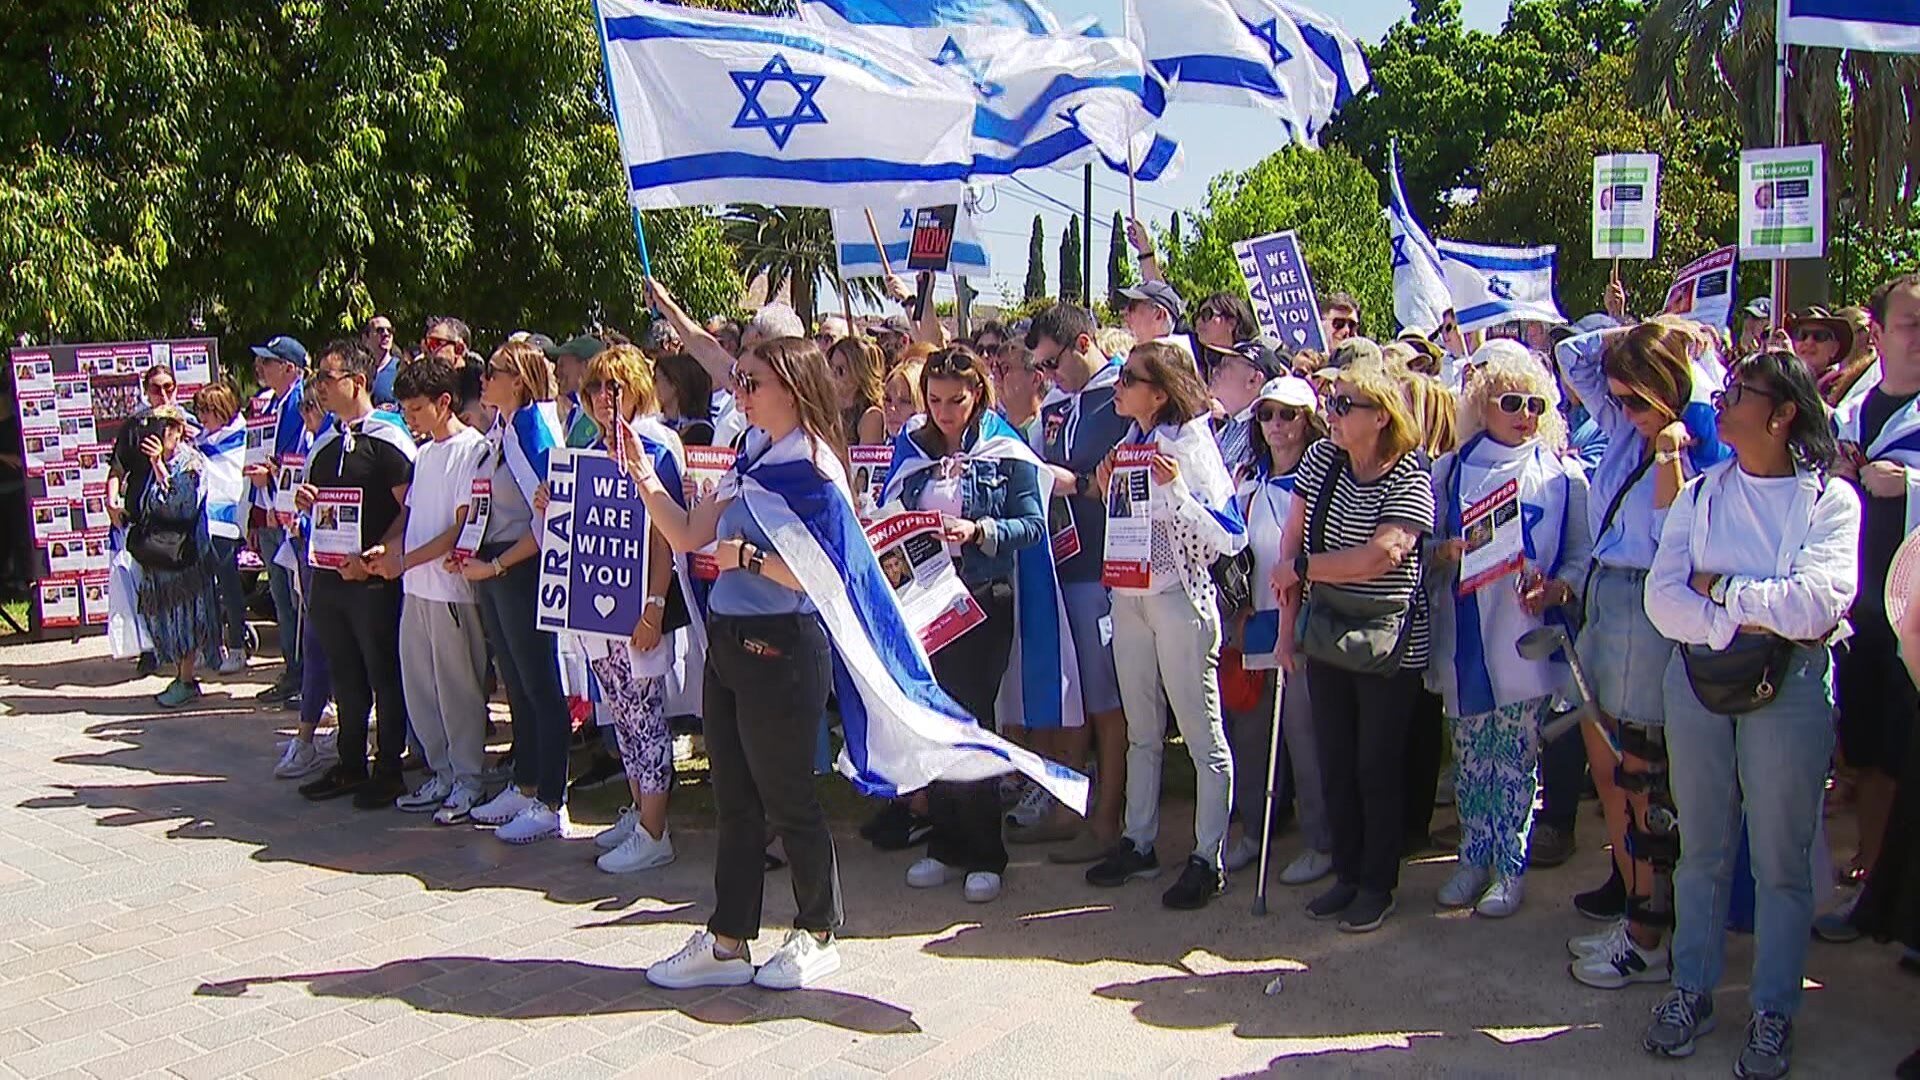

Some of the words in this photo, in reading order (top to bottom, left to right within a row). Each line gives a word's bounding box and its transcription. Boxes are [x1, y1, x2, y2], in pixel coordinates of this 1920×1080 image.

[913, 228, 951, 253] NOW
[1266, 250, 1289, 267] WE
[1271, 269, 1298, 287] ARE
[1270, 288, 1308, 307] WITH
[1280, 308, 1309, 325] YOU
[593, 477, 627, 498] WE
[586, 506, 631, 529] ARE
[540, 454, 576, 628] ISRAEL
[869, 516, 936, 547] DNAPPED
[577, 534, 639, 559] WITH
[581, 563, 631, 588] YOU
